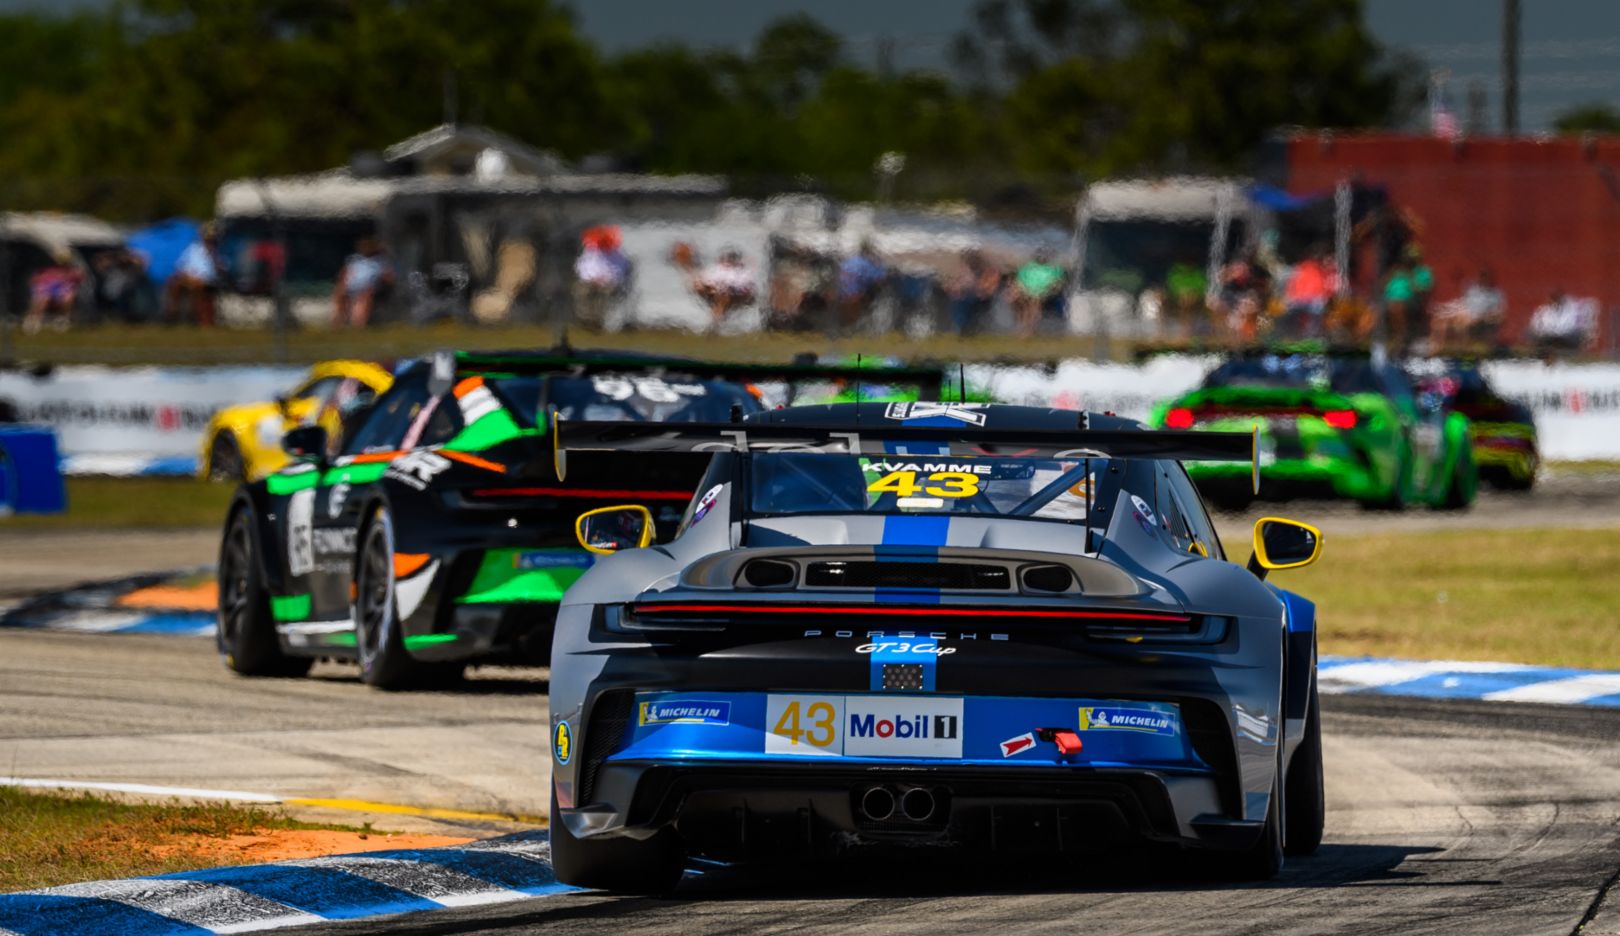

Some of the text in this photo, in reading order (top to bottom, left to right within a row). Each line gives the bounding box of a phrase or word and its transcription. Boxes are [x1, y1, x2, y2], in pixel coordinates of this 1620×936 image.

[862, 462, 992, 474] KVAMME
[867, 471, 979, 498] 43
[804, 630, 1009, 641] PORSCHE
[659, 707, 720, 718] MICHELIN
[772, 701, 836, 747] 43
[850, 714, 953, 739] Mobil 1
[1111, 715, 1169, 729] MICHELIN
